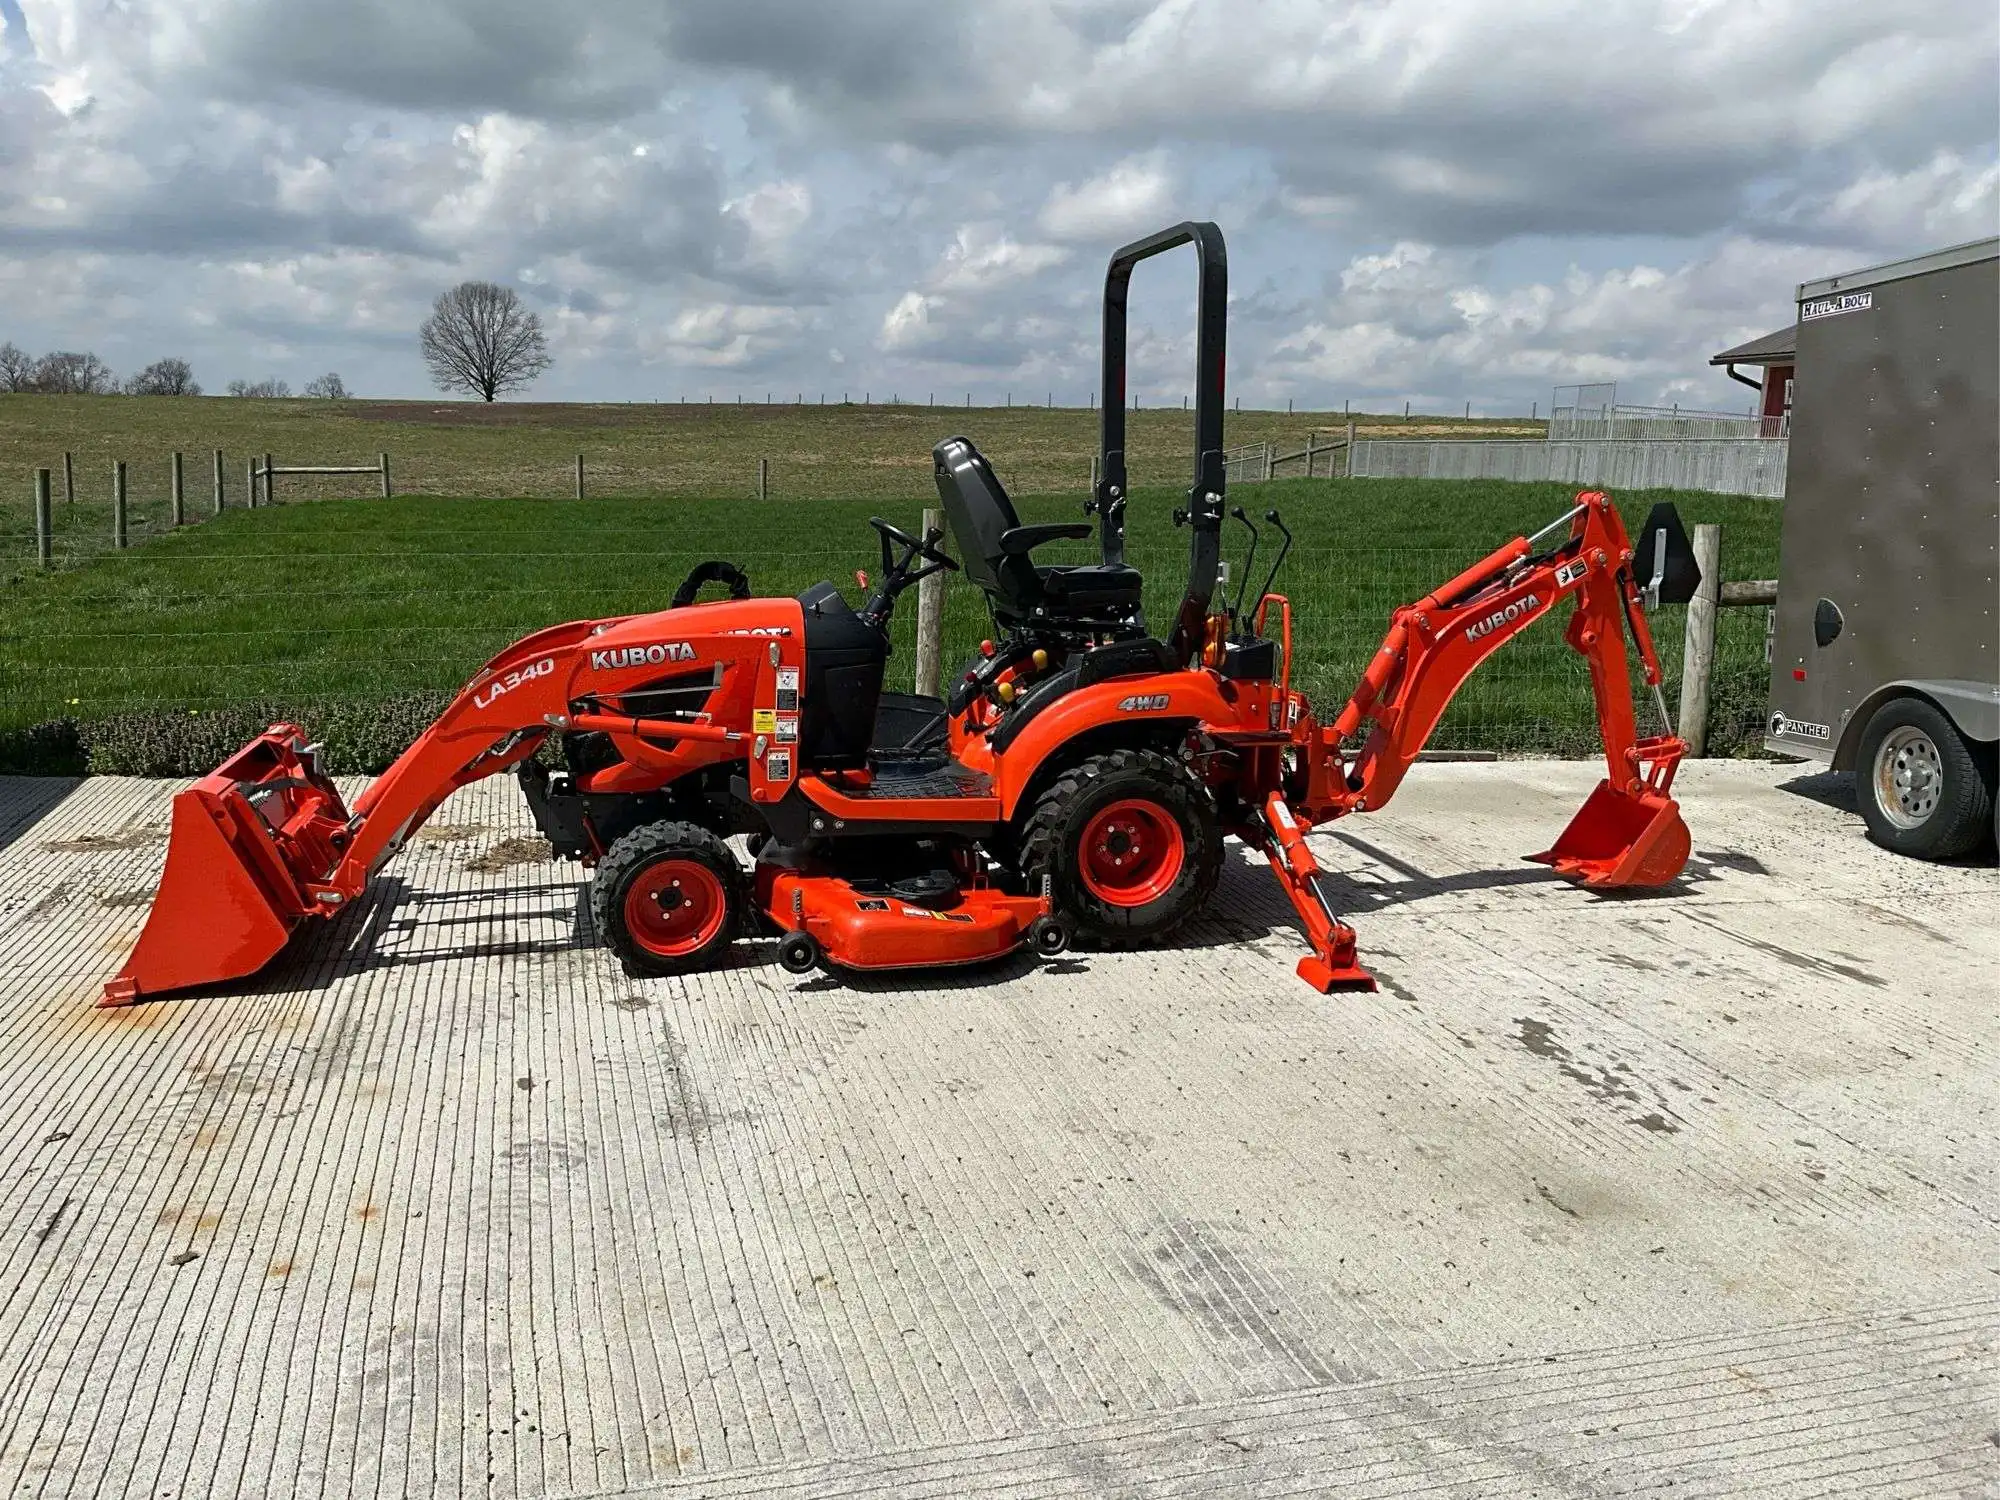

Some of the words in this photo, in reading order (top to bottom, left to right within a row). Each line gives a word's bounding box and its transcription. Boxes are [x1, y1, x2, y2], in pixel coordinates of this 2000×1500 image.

[1465, 594, 1541, 643] KUBOTA
[591, 642, 697, 670] KUBOTA
[473, 658, 554, 709] LA340
[1117, 695, 1170, 711] 4WD
[1786, 721, 1828, 738] PANTHER
